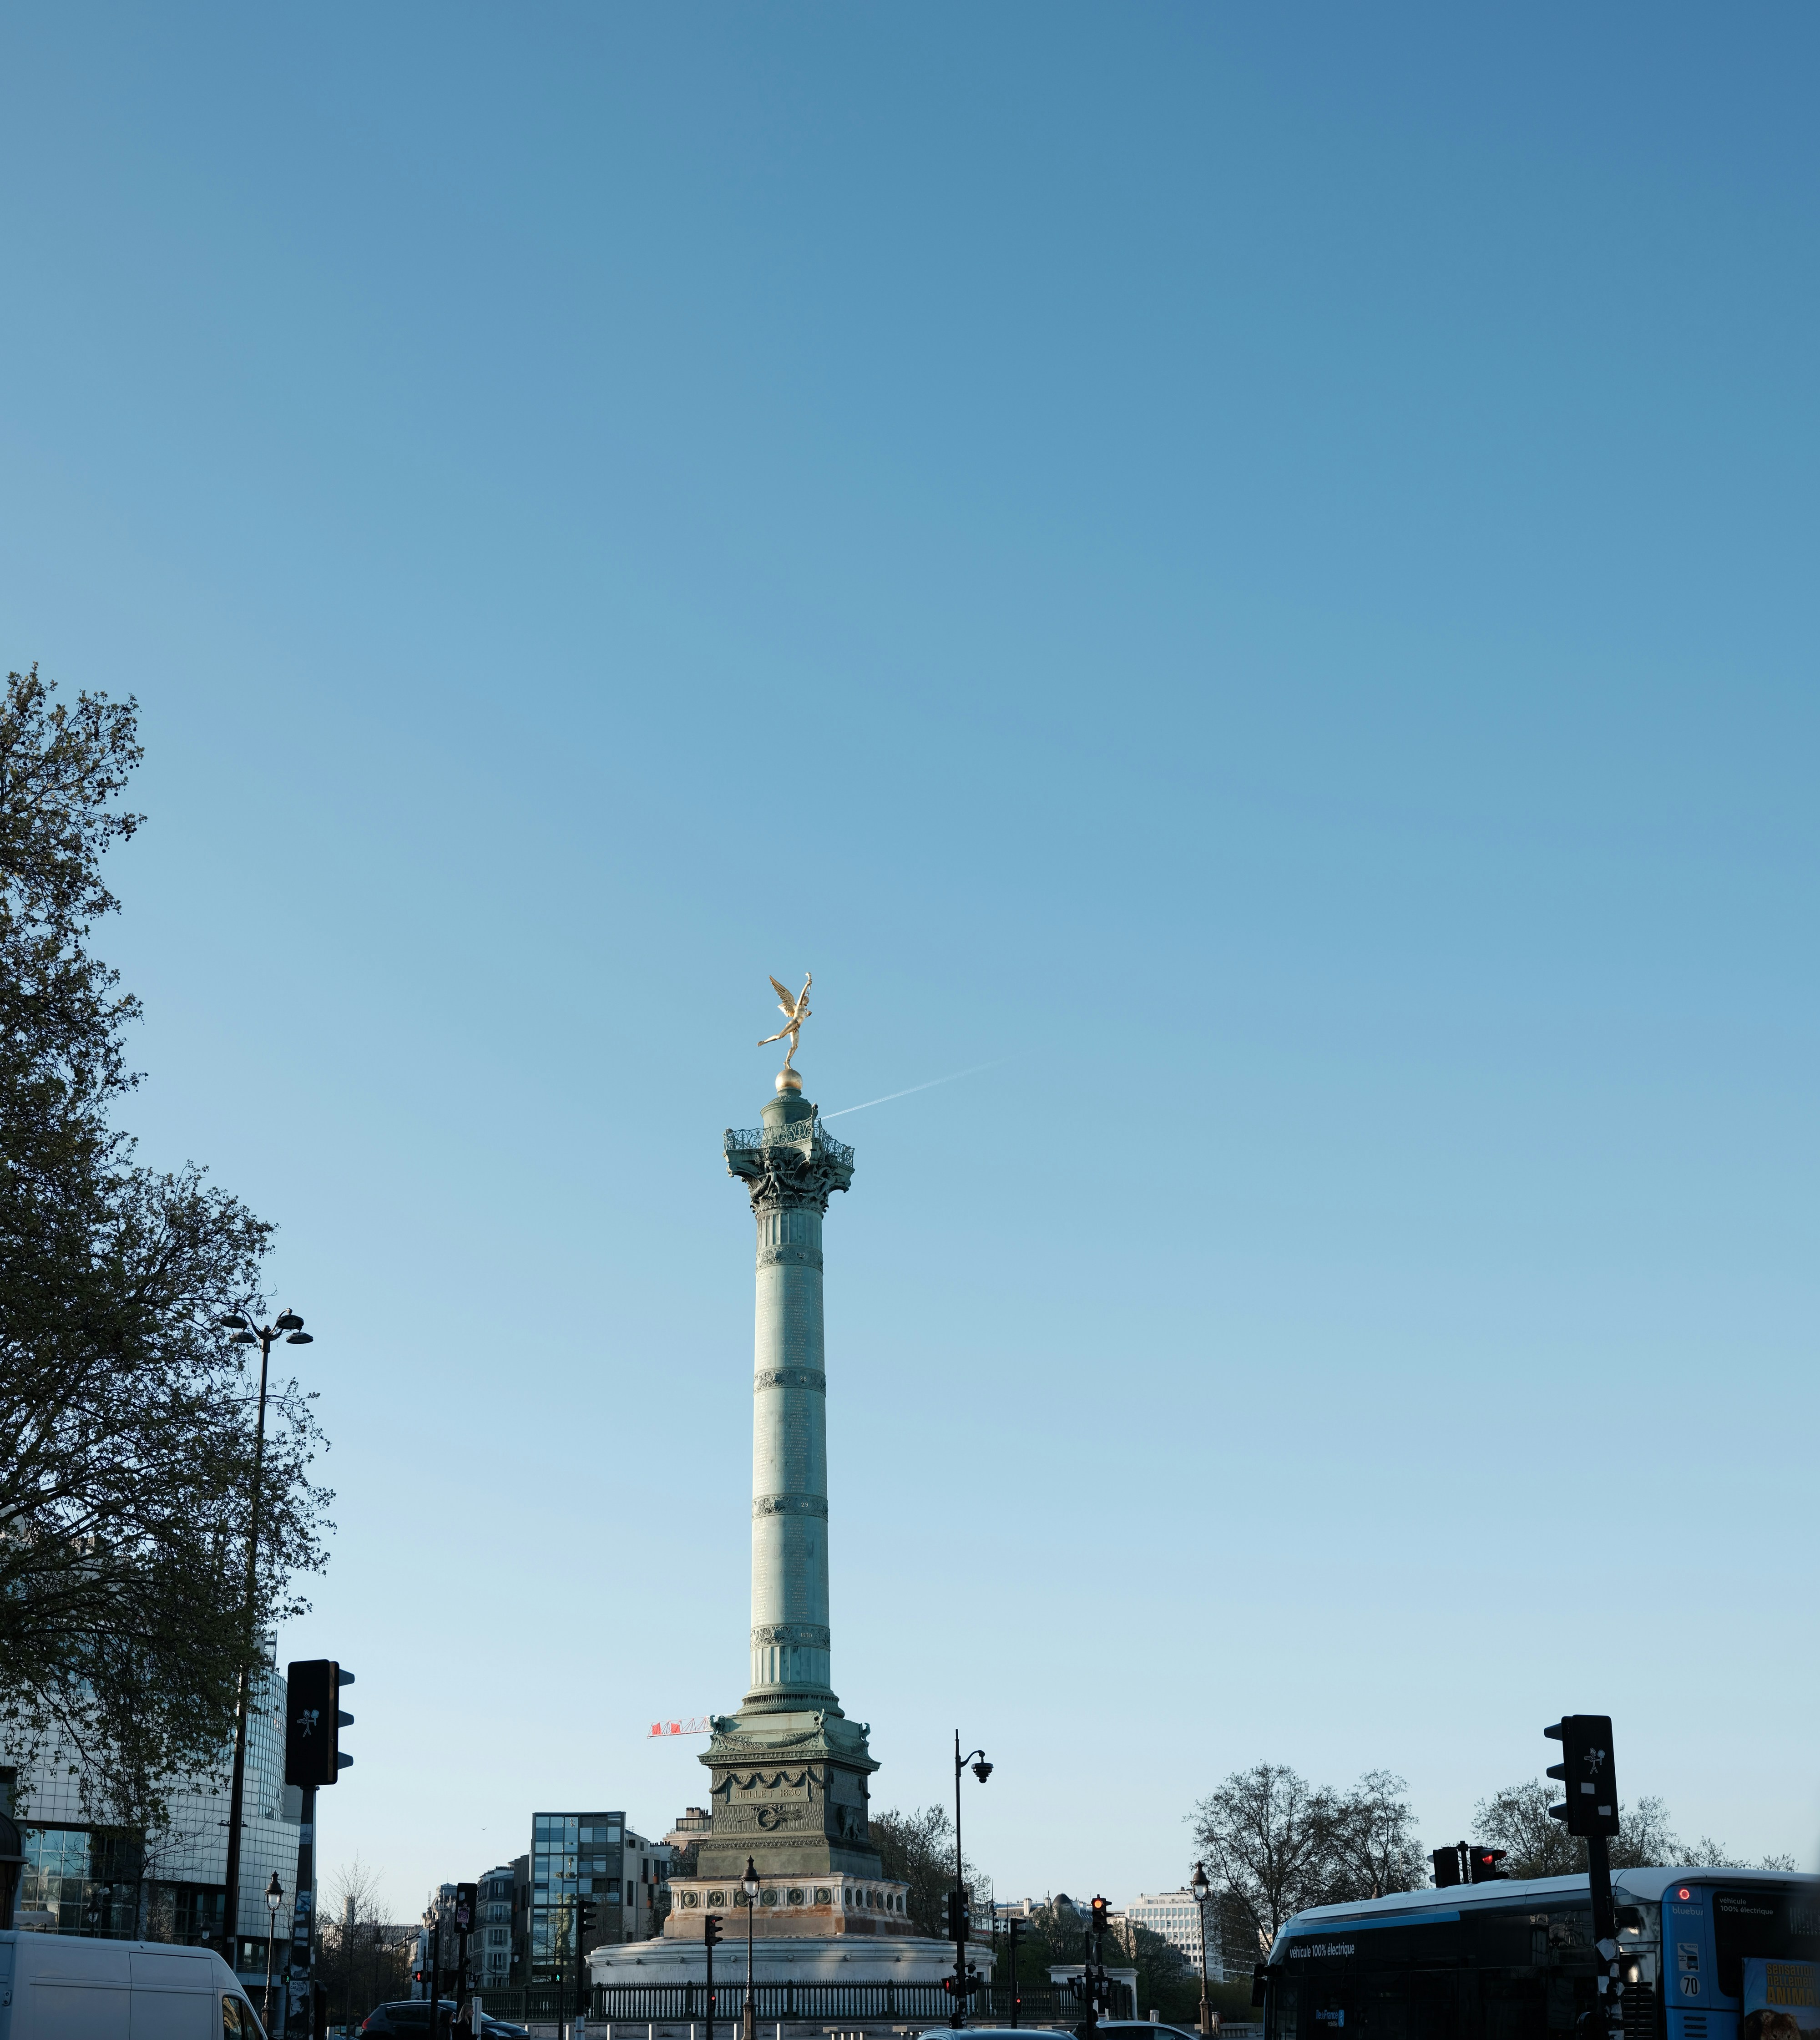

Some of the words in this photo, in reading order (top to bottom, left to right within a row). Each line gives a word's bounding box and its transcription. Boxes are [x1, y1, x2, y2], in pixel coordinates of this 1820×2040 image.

[734, 1790, 774, 1799] JUILLET
[780, 1788, 801, 1797] 1830
[1672, 1906, 1704, 1916] bluebus
[1740, 1906, 1774, 1915] électrique
[1289, 1945, 1311, 1958] véhicule
[1312, 1944, 1326, 1957] 100%
[1327, 1942, 1355, 1957] électrique
[1684, 1977, 1698, 1994] 70
